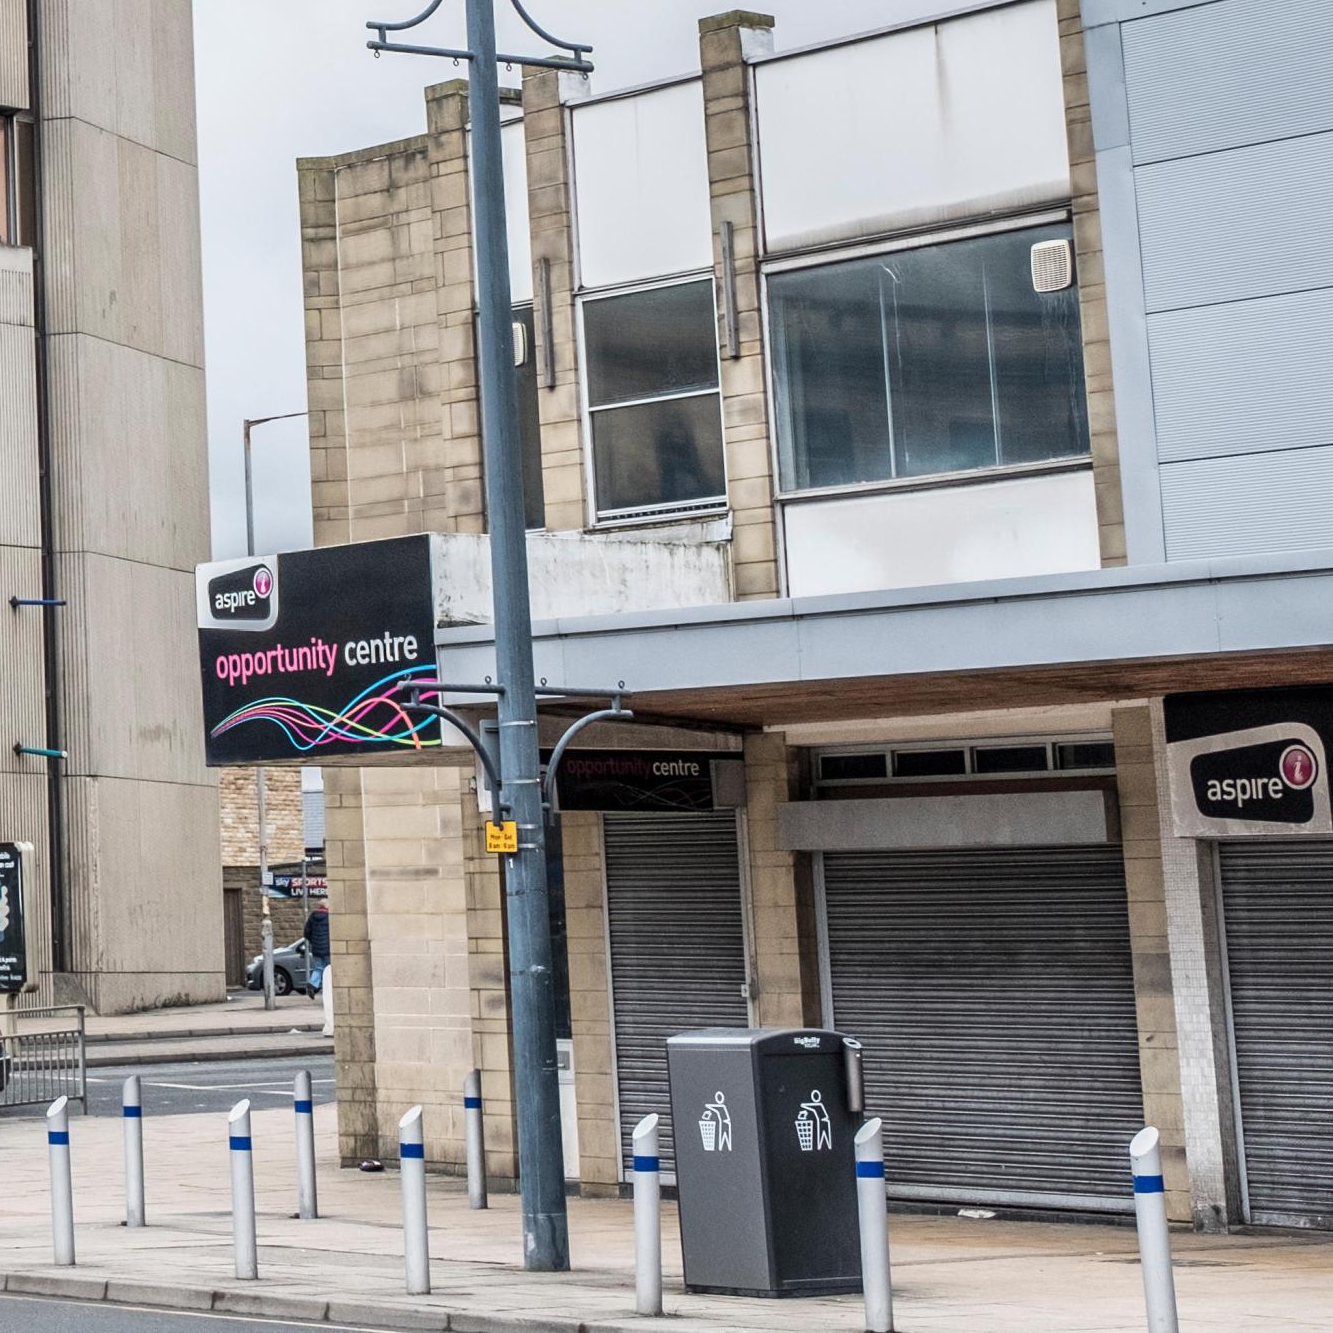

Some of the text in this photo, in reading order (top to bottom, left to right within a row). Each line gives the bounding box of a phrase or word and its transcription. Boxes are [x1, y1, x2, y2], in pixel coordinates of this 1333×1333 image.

[215, 588, 256, 613] aspire
[216, 630, 419, 687] opportunity centre
[566, 758, 700, 780] opportunity centre
[1207, 777, 1284, 808] aspire
[274, 877, 290, 887] sky
[291, 888, 307, 896] LIV
